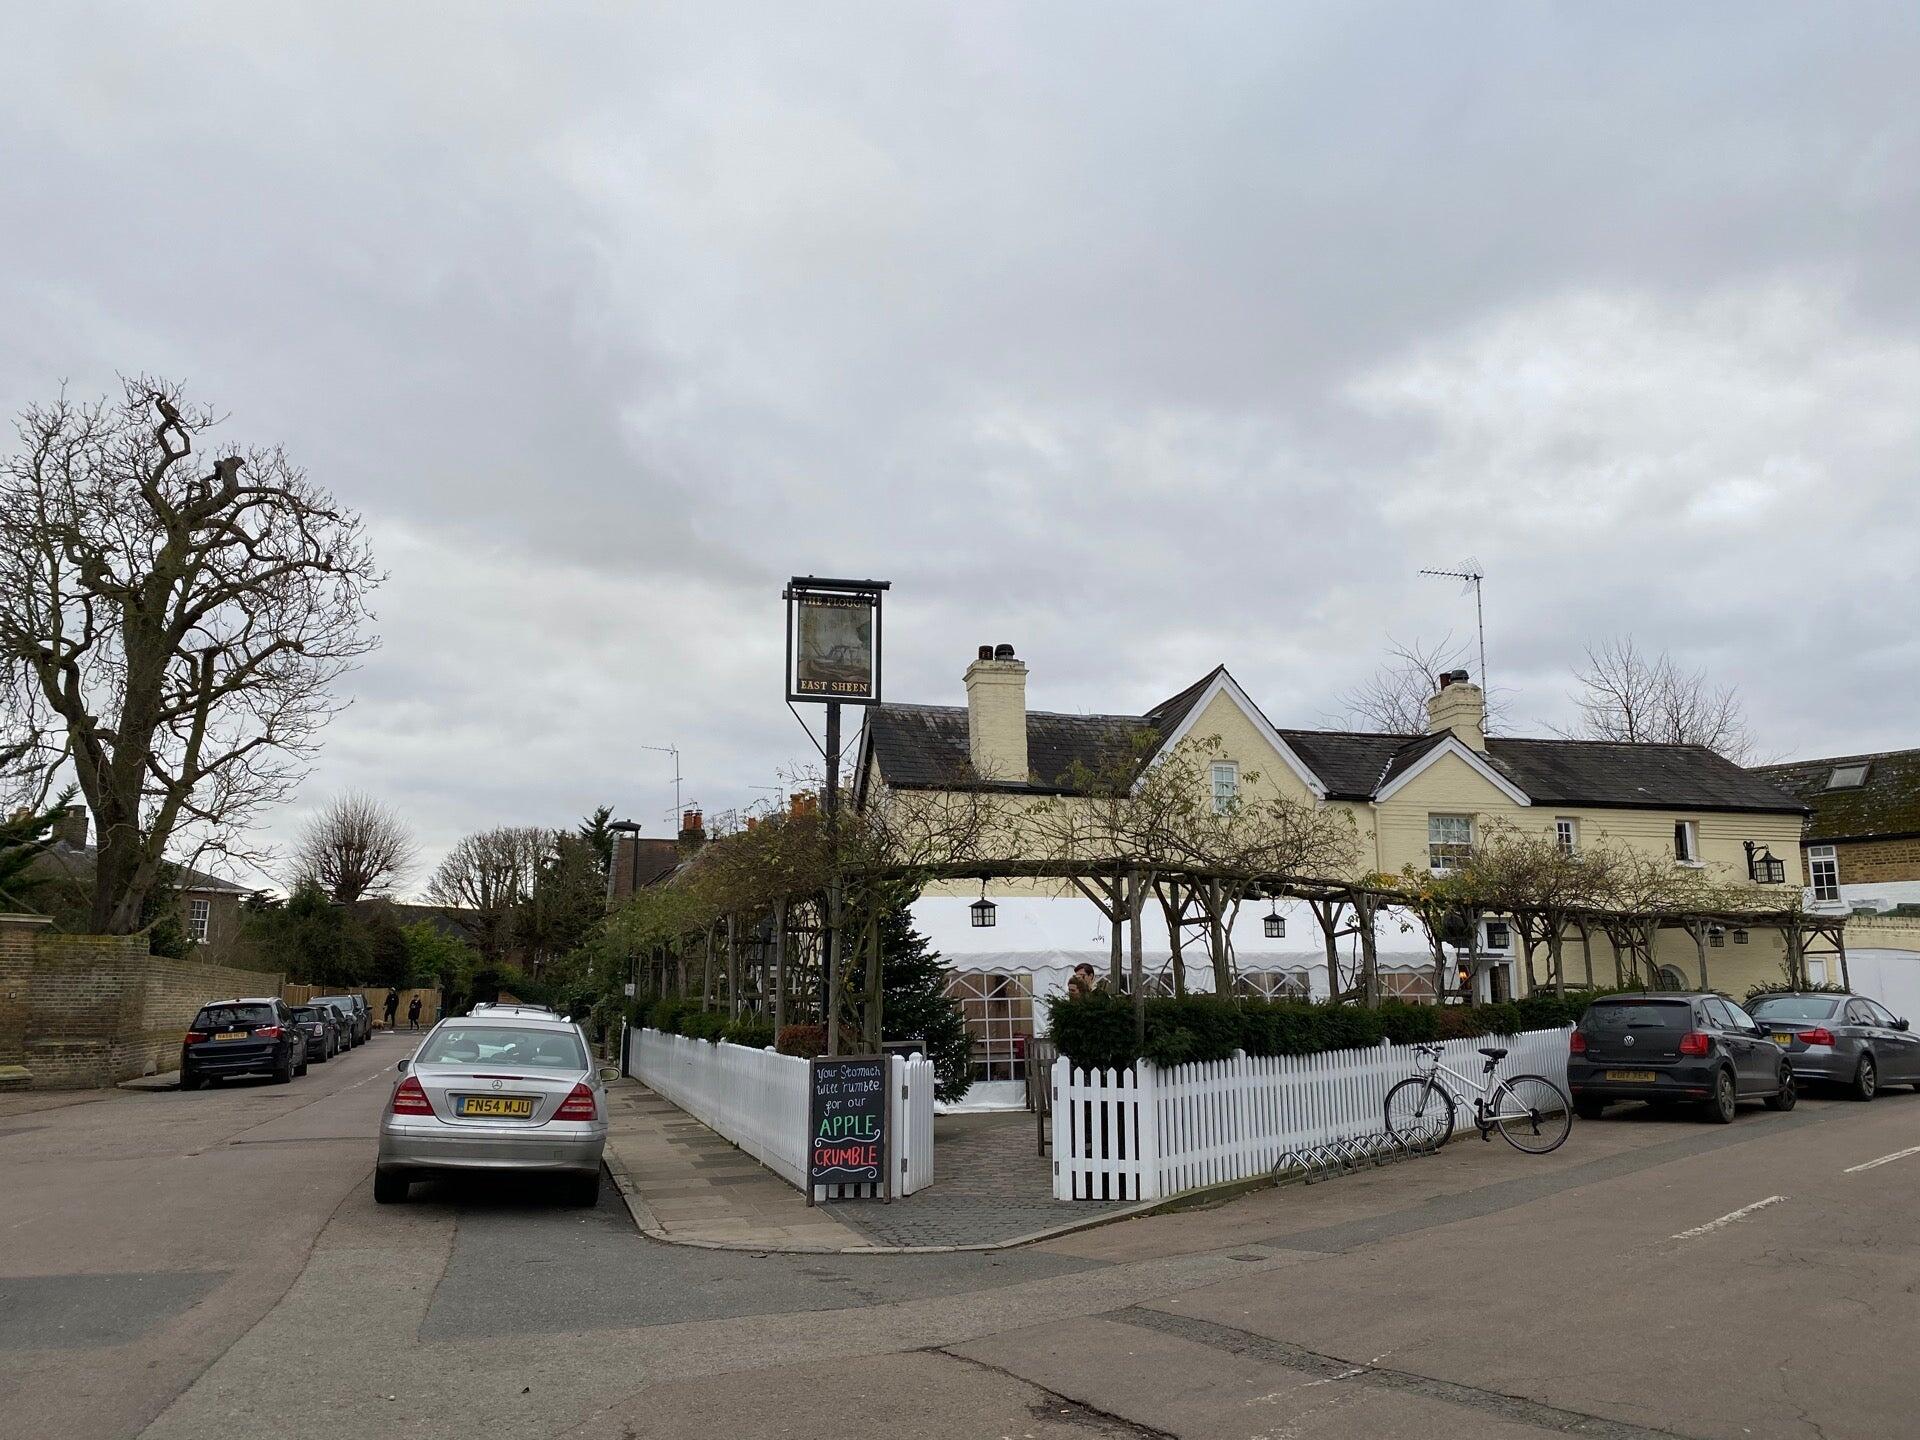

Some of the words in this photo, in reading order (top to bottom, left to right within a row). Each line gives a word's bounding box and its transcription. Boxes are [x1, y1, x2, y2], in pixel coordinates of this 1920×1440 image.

[803, 596, 822, 606] THE
[801, 680, 828, 691] EAST
[831, 682, 868, 693] SHEEN
[840, 1064, 881, 1080] Stomach
[816, 1083, 838, 1096] will
[466, 1099, 501, 1112] FN54
[503, 1100, 530, 1114] MJU
[823, 1100, 843, 1117] for
[847, 1097, 867, 1108] our
[819, 1114, 877, 1137] APPLE
[814, 1145, 879, 1167] CRUMBLE
